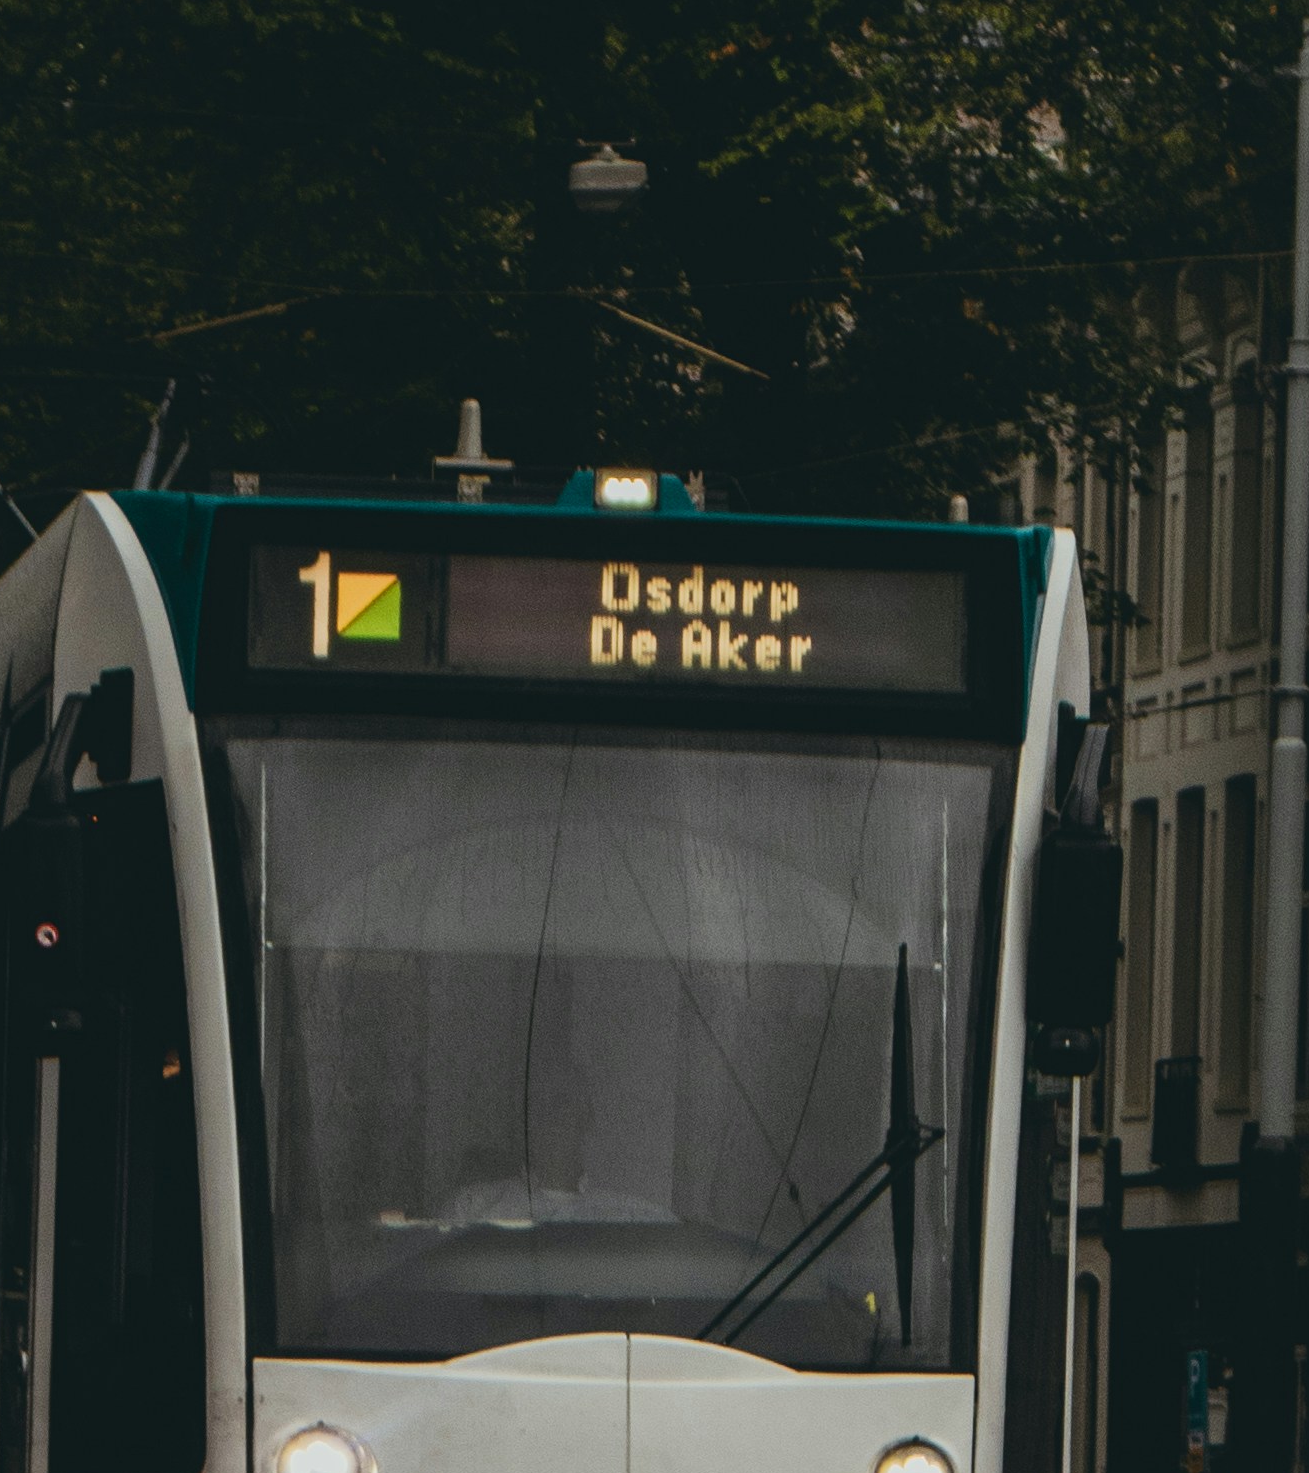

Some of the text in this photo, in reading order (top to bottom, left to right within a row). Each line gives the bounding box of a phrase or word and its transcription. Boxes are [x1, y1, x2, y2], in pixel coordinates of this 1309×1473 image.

[299, 550, 330, 658] 1
[602, 561, 798, 622] Osdorp
[592, 614, 811, 672] De Aker
